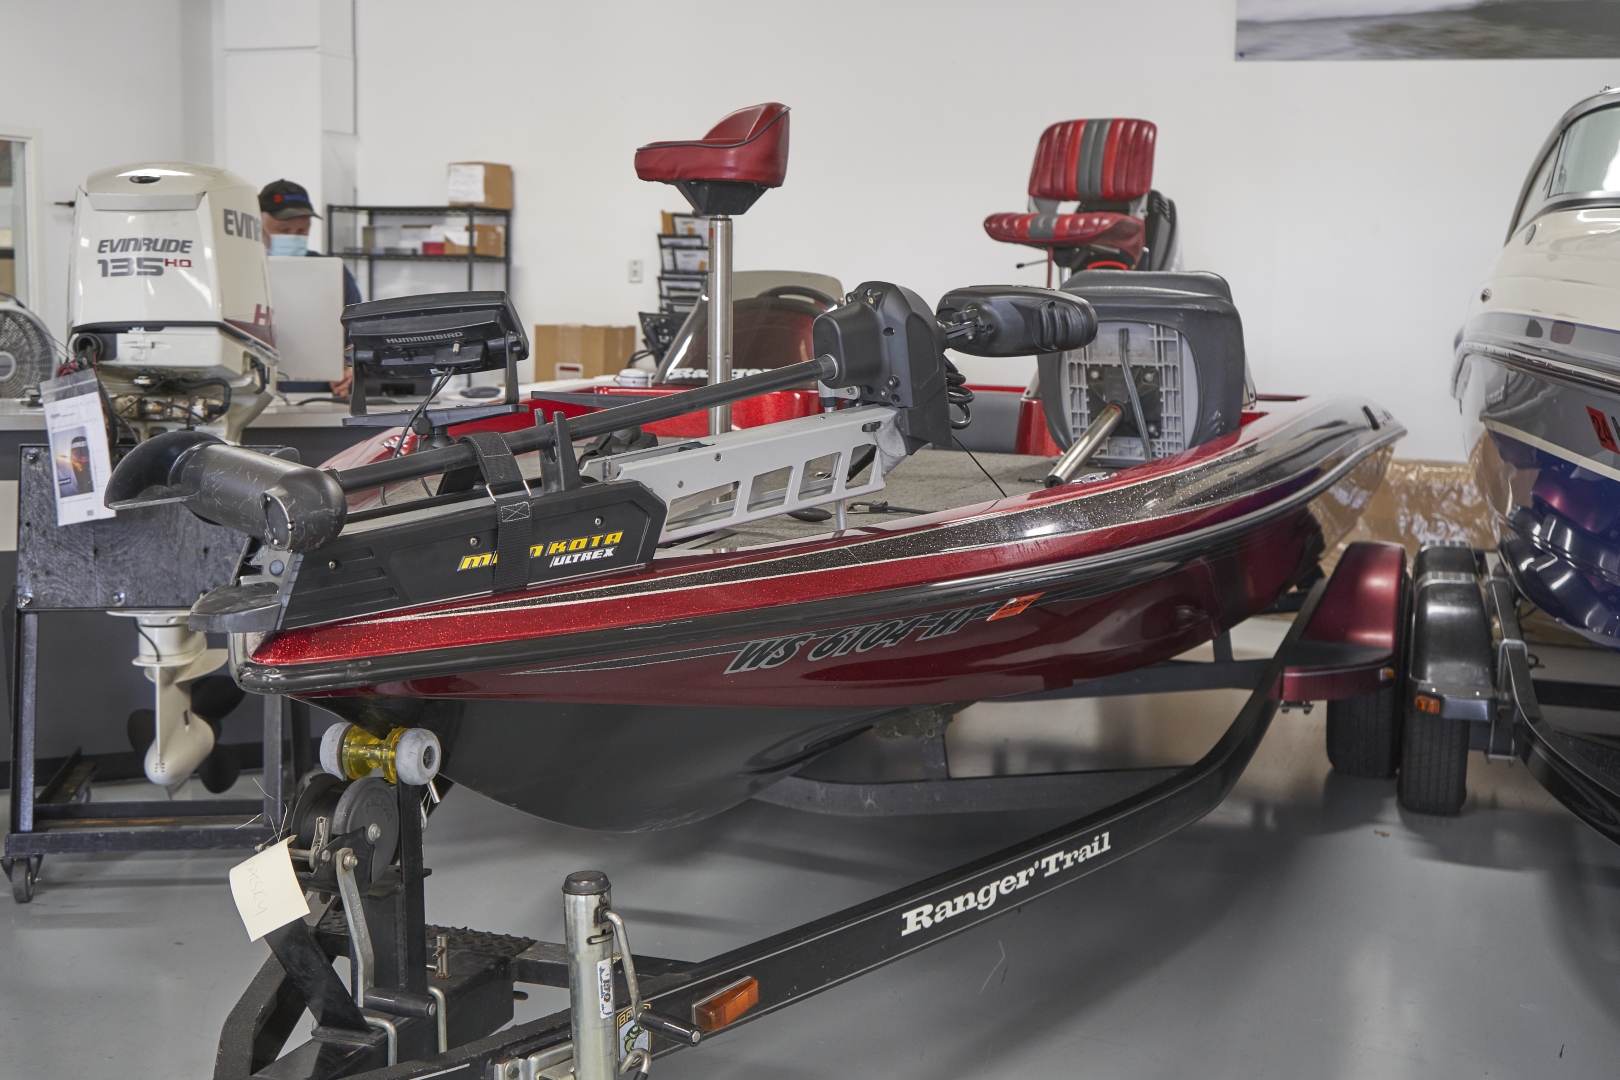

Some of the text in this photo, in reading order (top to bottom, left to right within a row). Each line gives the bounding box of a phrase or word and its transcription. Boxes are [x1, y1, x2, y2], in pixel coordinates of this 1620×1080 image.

[97, 237, 193, 254] EVINRUDE
[98, 257, 164, 277] 135
[386, 331, 463, 344] HUMMINBIRD
[1591, 414, 1615, 447] 24
[545, 530, 624, 556] KOTA
[549, 546, 616, 568] ULTREX
[723, 633, 816, 675] WS
[807, 615, 931, 662] 6104
[1041, 831, 1111, 877] Trail
